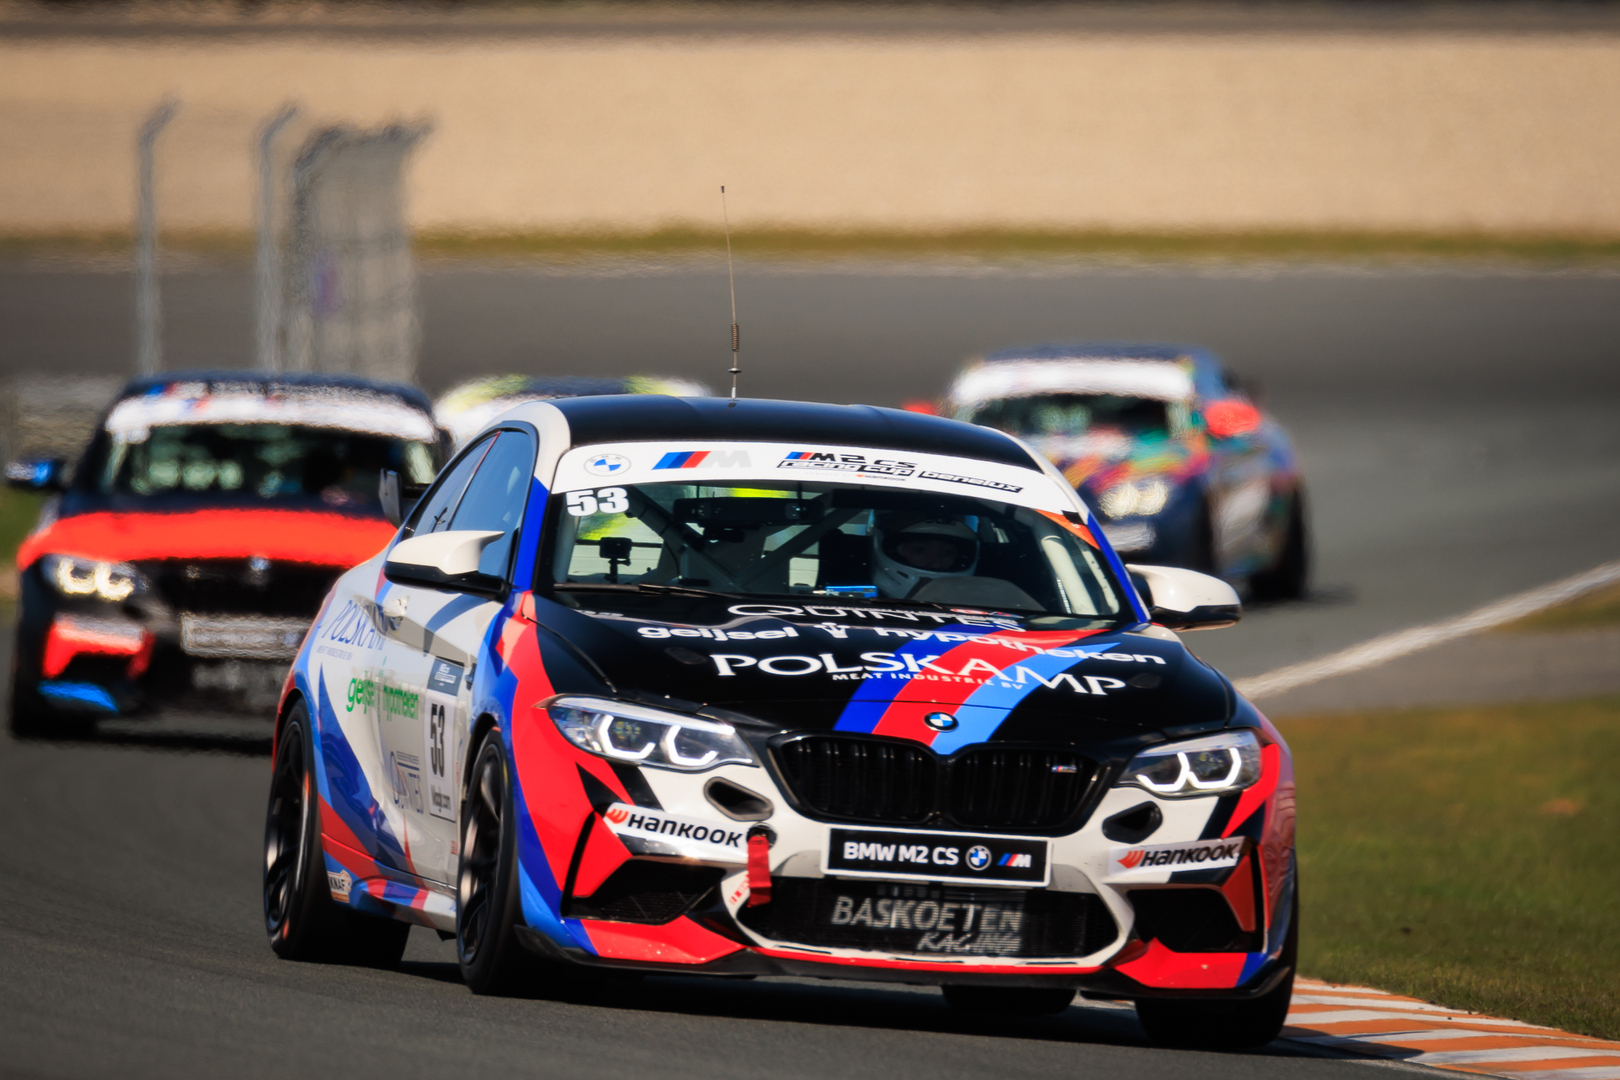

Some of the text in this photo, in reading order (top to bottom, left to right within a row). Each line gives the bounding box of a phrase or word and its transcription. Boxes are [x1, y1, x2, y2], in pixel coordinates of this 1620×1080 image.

[810, 452, 918, 468] M2 CS
[919, 471, 1023, 493] benelux
[566, 487, 630, 517] 53
[637, 626, 1165, 664] geijsel hypotheken
[709, 651, 1126, 695] POLSKAMP
[832, 673, 882, 681] MEAT
[890, 673, 993, 686] INDUSTRIE
[430, 703, 445, 778] 53
[843, 841, 896, 862] BMW
[898, 844, 929, 864] M2
[932, 847, 959, 866] CS
[831, 896, 1023, 932] BASKOETEN
